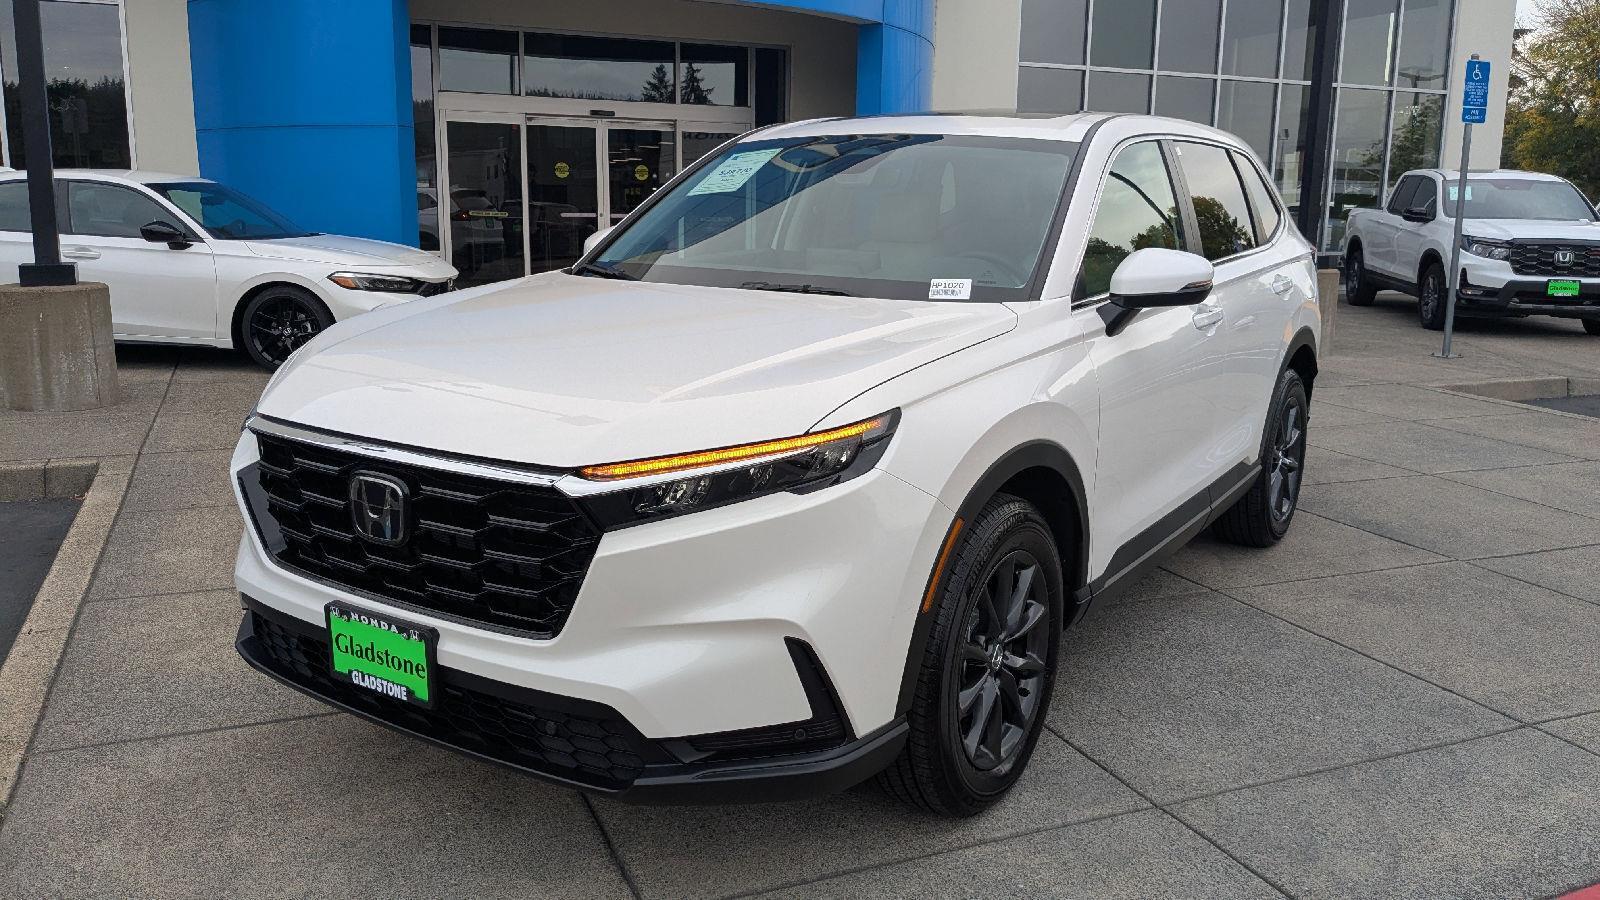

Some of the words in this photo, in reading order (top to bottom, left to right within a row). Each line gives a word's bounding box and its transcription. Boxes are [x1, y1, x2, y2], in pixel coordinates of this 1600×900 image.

[350, 611, 399, 634] HONDA
[334, 632, 426, 680] Gladstone
[351, 670, 408, 701] GLADSTONE
